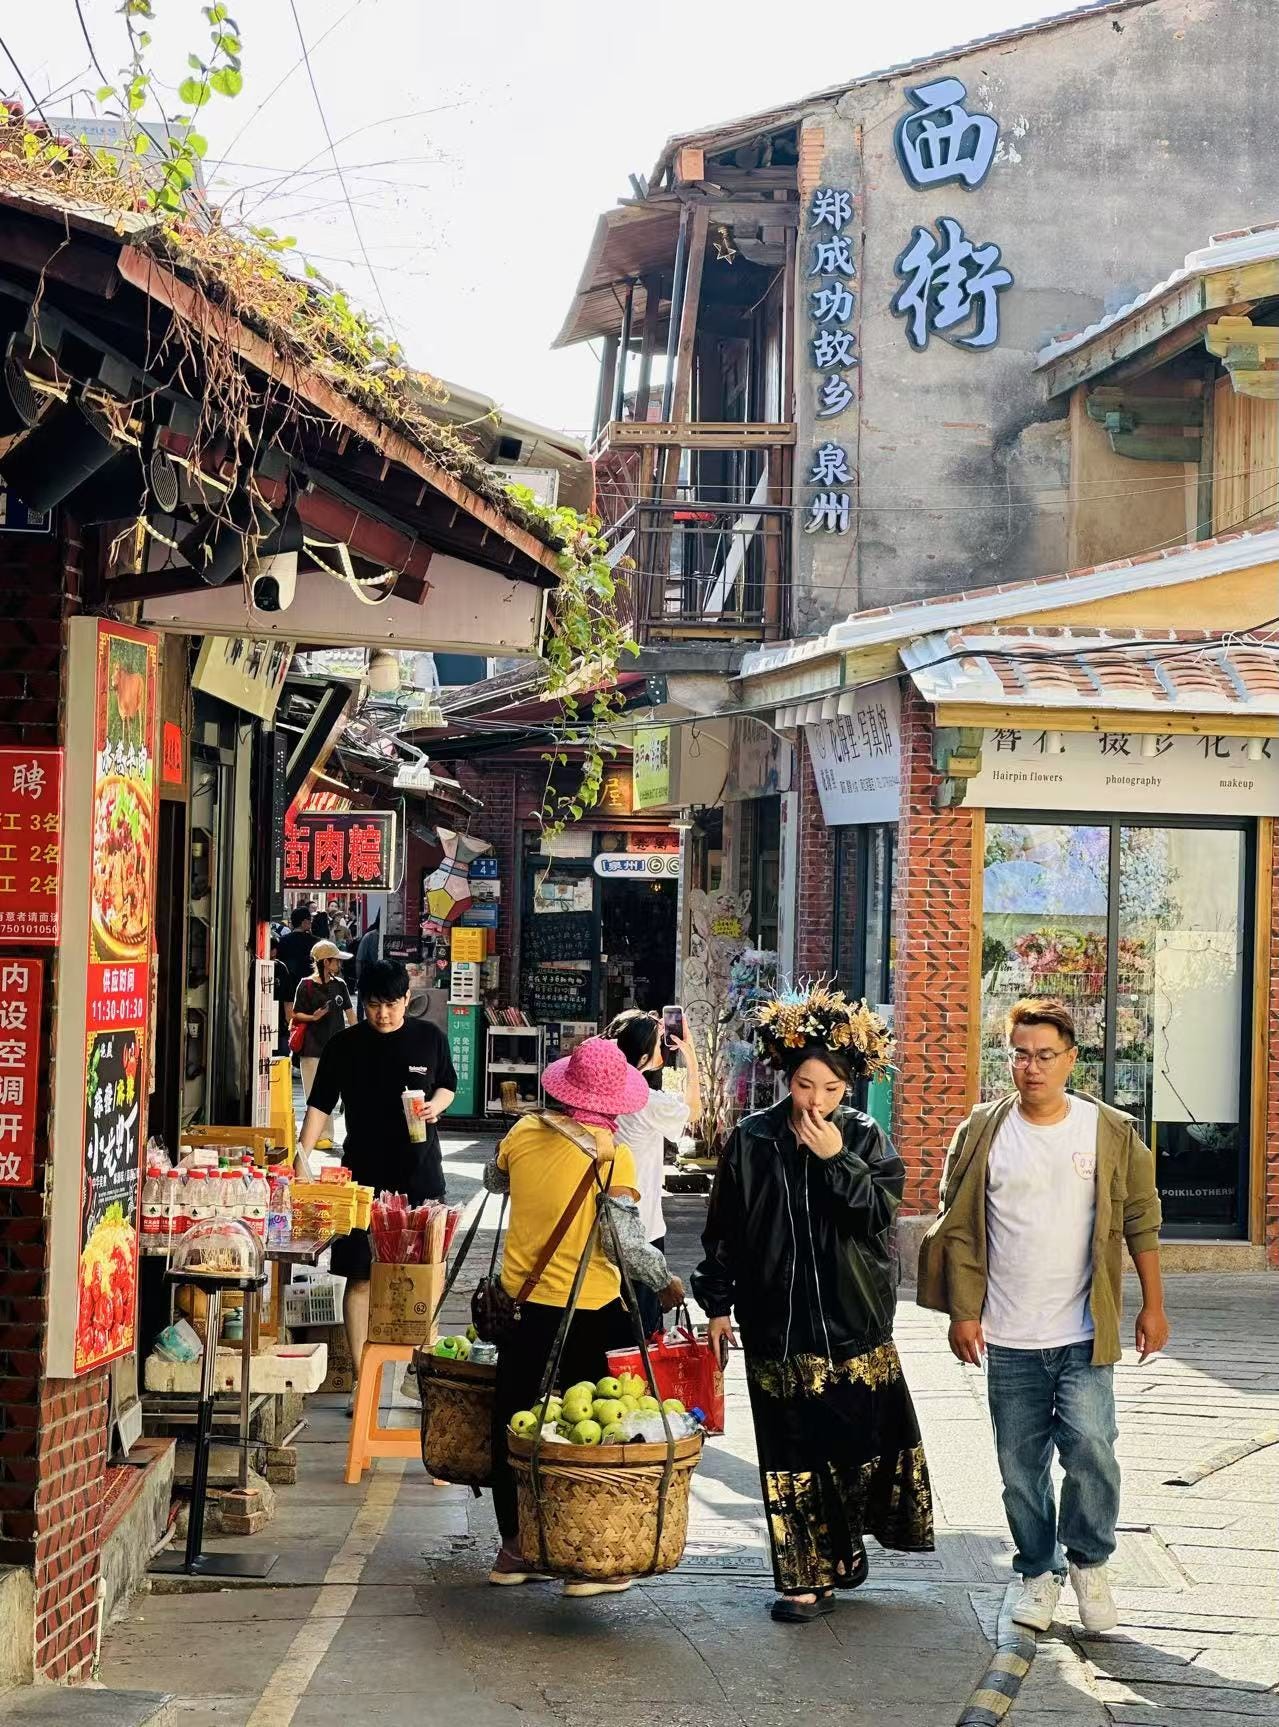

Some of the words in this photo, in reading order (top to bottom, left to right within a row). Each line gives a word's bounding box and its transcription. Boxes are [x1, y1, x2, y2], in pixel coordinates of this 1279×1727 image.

[893, 77, 1014, 352] 西街
[810, 188, 859, 418] 郑成功故乡
[804, 443, 856, 535] 泉州
[11, 759, 47, 800] 聘
[992, 770, 1028, 782] Hairpin
[1029, 771, 1064, 782] flowers
[1105, 774, 1163, 787] photography
[1219, 778, 1255, 789] makeup
[30, 812, 60, 833] 3名
[29, 843, 60, 864] 2名
[480, 865, 486, 875] 4
[102, 968, 135, 993] 供应时间
[92, 998, 143, 1021] 11:30-01:30
[0, 963, 29, 1182] 内设空调开放
